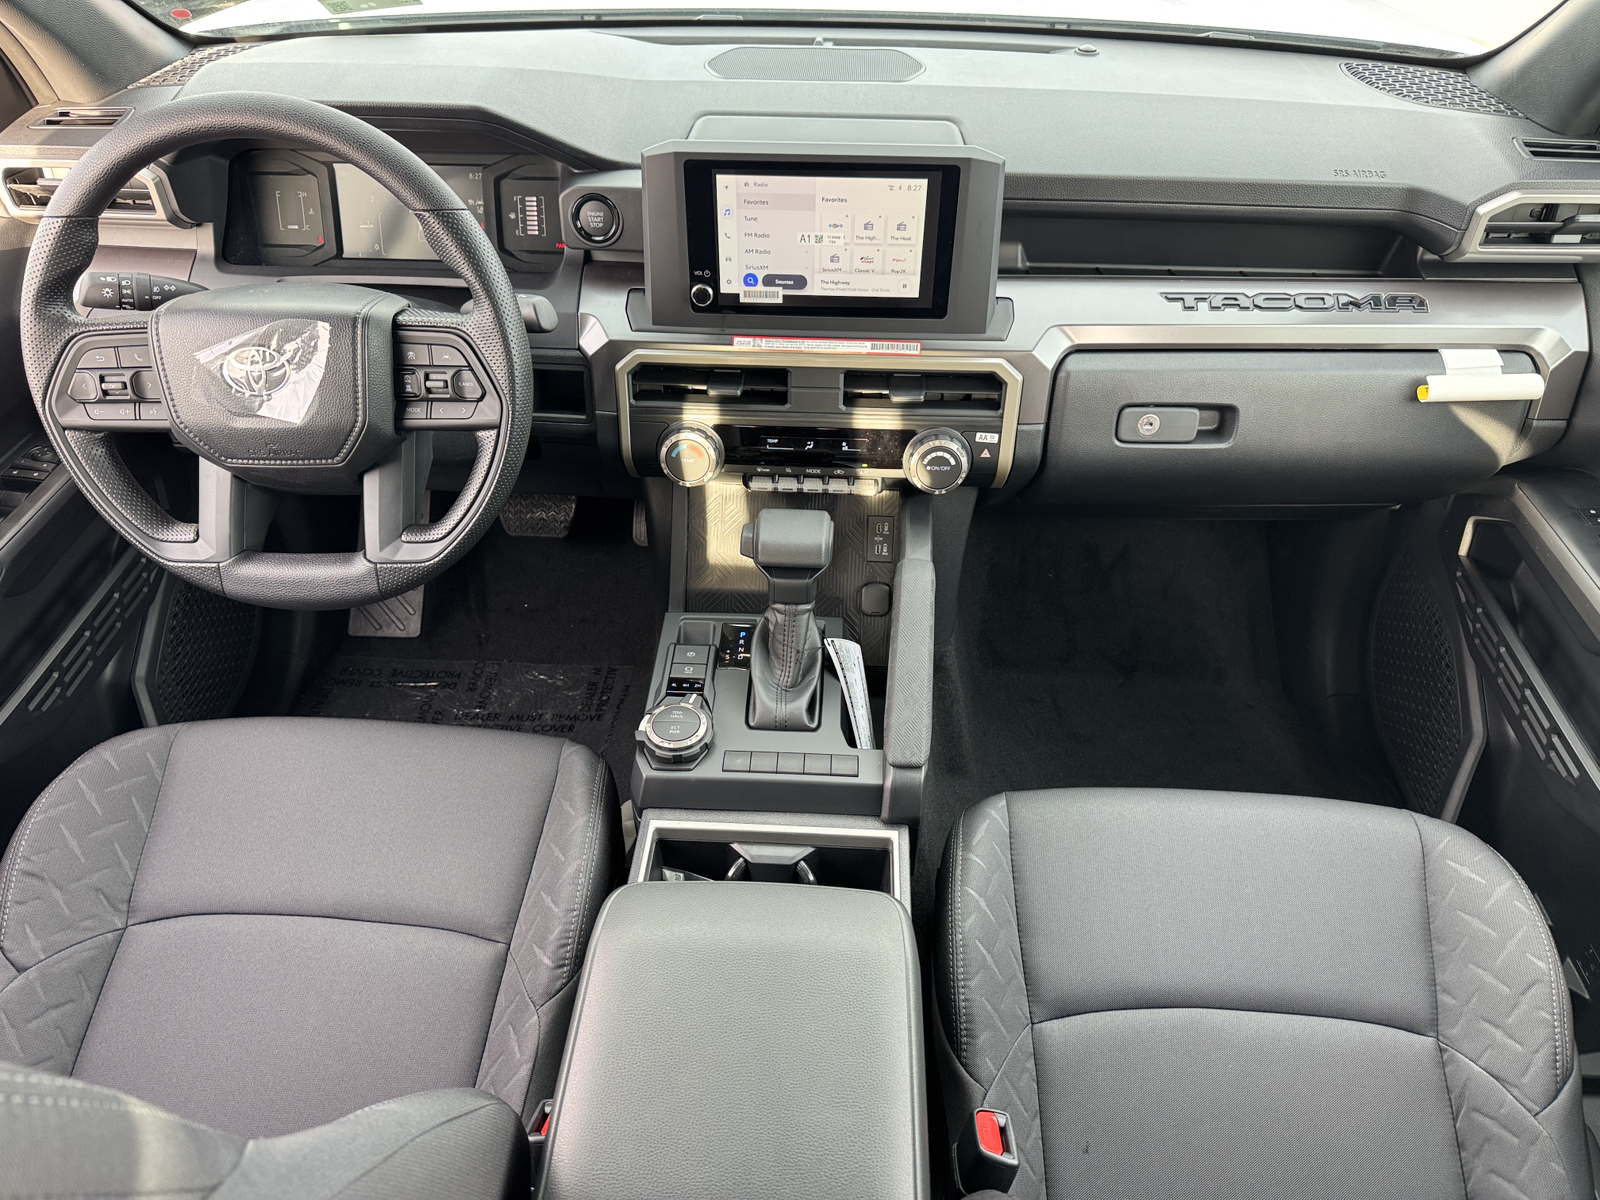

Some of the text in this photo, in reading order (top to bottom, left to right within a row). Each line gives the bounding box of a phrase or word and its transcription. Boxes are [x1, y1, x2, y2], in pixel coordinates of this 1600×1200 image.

[468, 172, 482, 180] 8:27
[1333, 169, 1387, 179] SRS AIRBAG
[799, 233, 811, 243] A1
[1157, 290, 1430, 314] TACOMA
[340, 667, 462, 679] PROTECTIVE COVER
[579, 681, 599, 713] DEALER
[454, 712, 605, 722] DEALER MUST REMOVE
[532, 724, 576, 733] COVER
